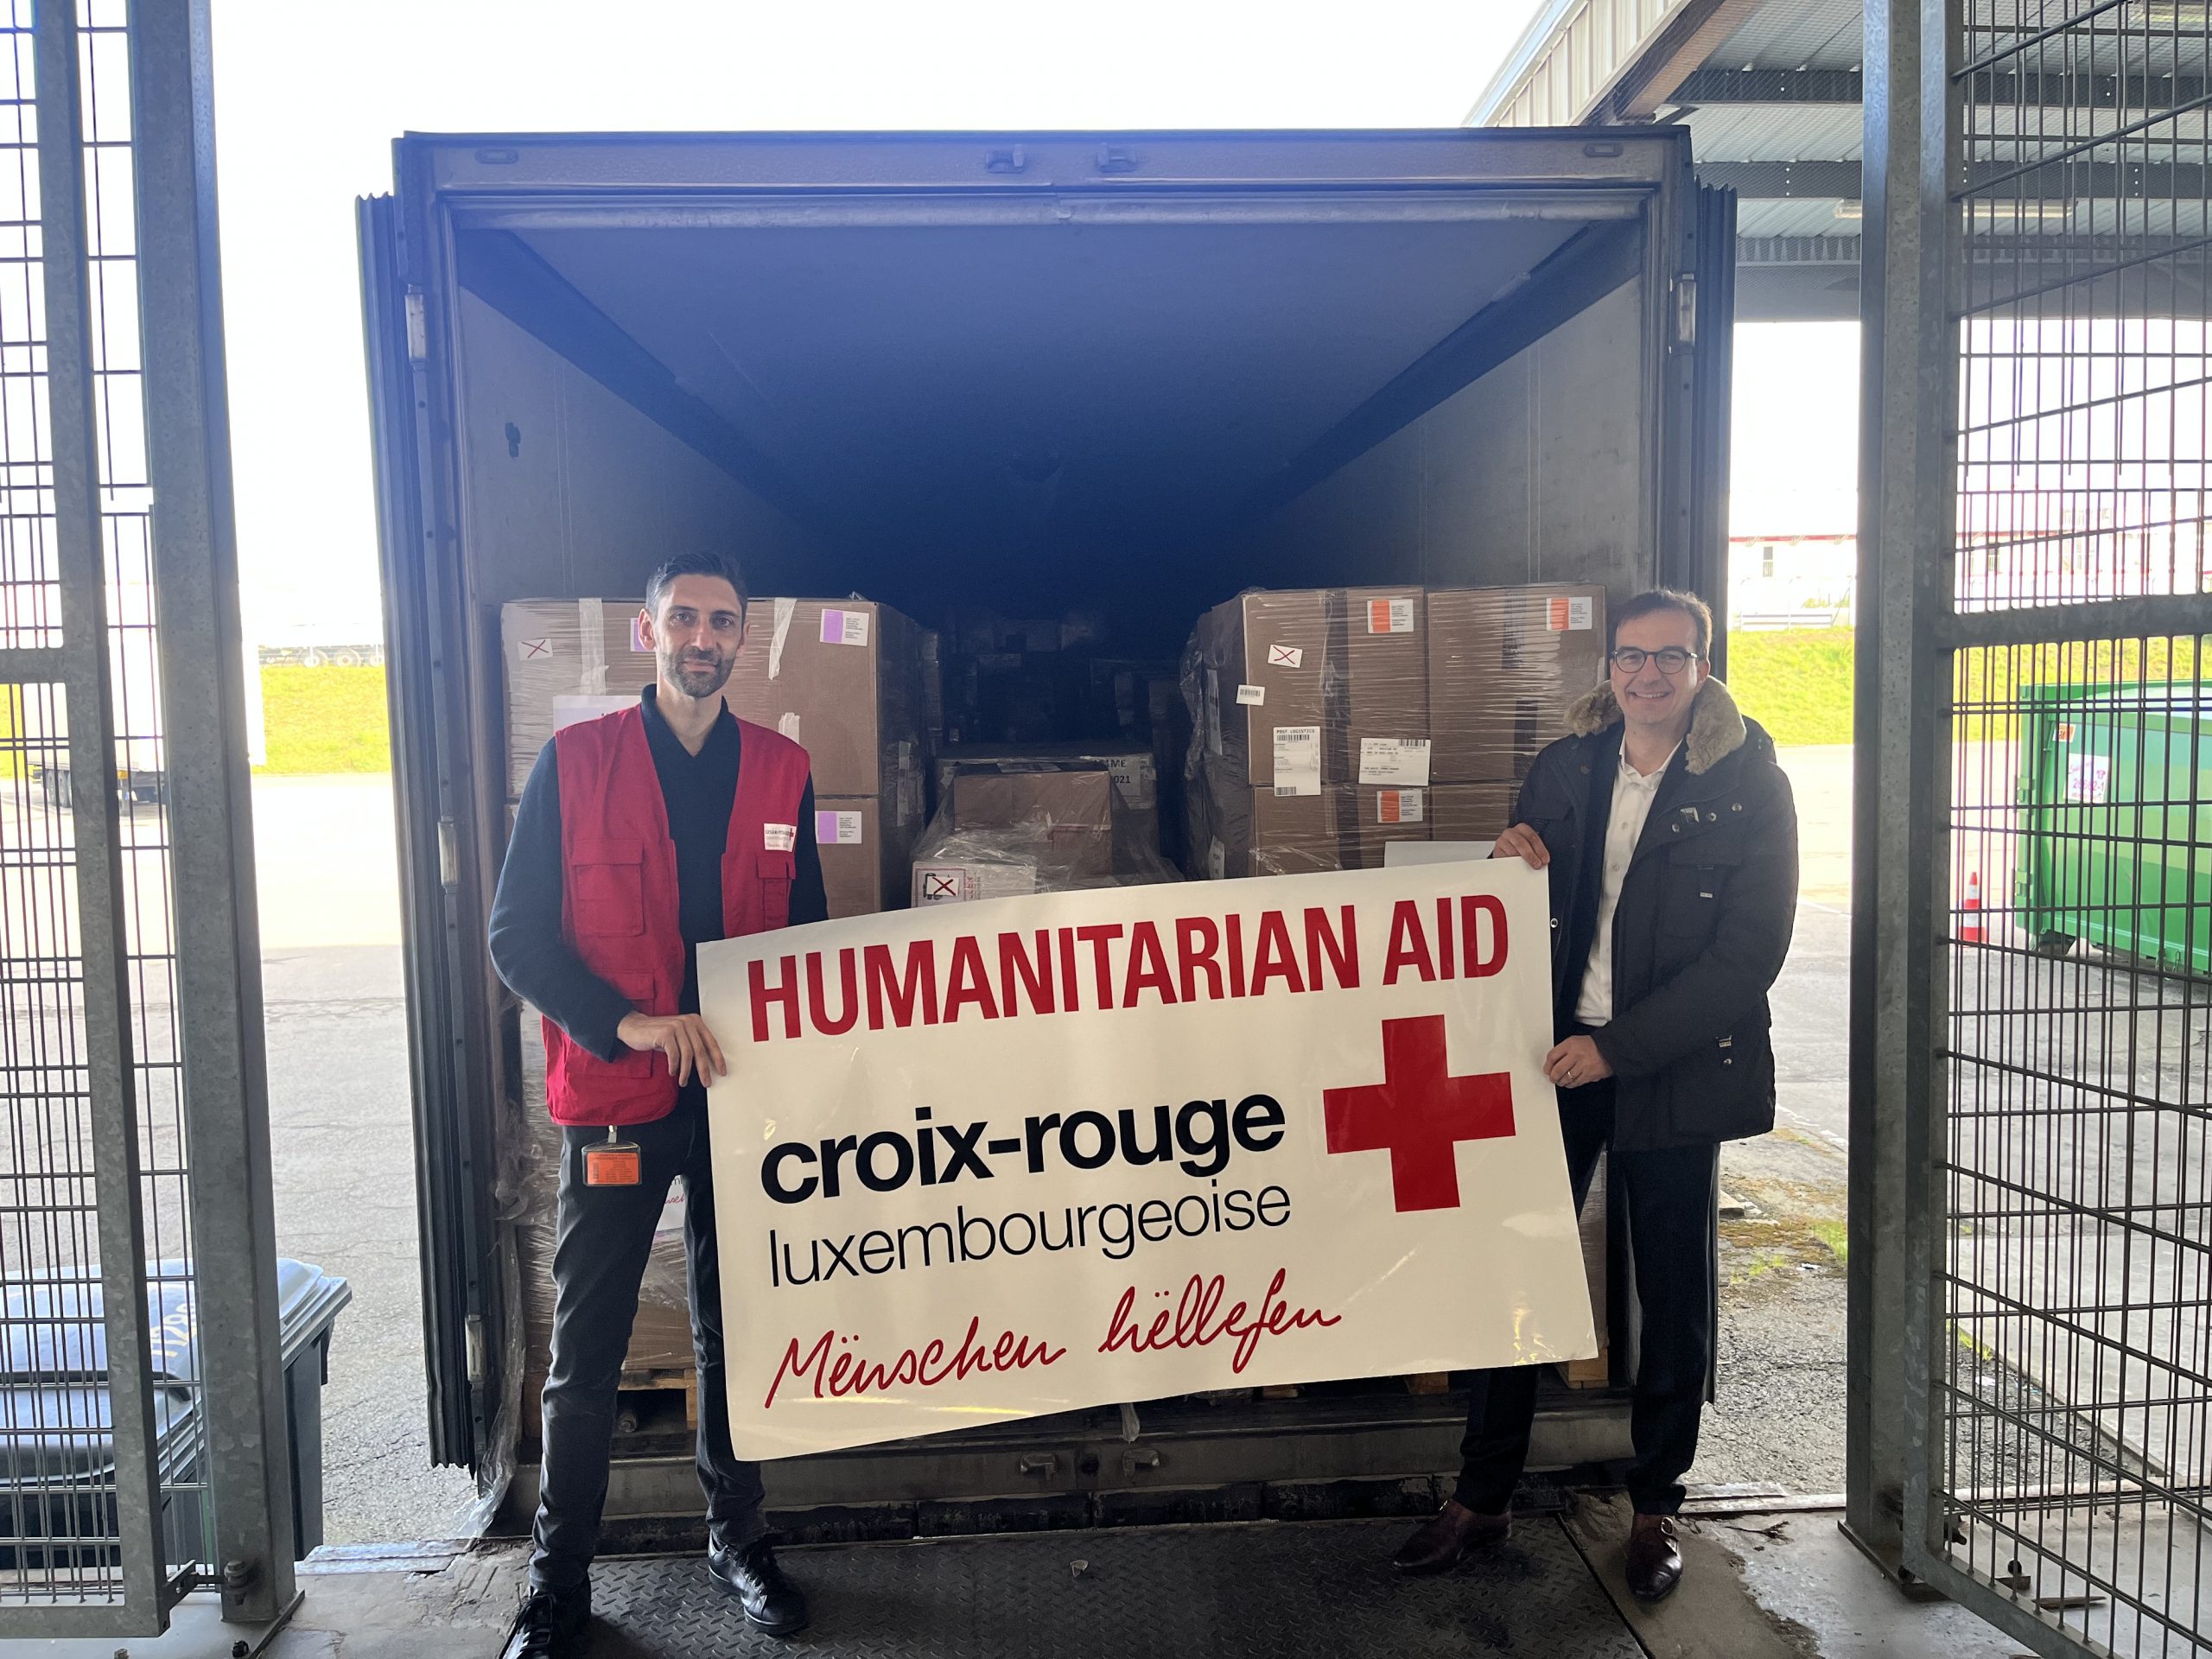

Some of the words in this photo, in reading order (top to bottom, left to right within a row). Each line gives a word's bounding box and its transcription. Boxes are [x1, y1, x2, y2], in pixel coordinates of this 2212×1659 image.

[1114, 775, 1130, 784] 021
[748, 905, 1360, 1042] HUMANITARIAN
[1382, 895, 1508, 985] AID
[761, 1094, 1285, 1204] croix-rouge
[770, 1179, 1291, 1287] luxembourgeoise
[765, 1317, 1065, 1409] Mënschen
[1098, 1268, 1341, 1374] hëllefen
